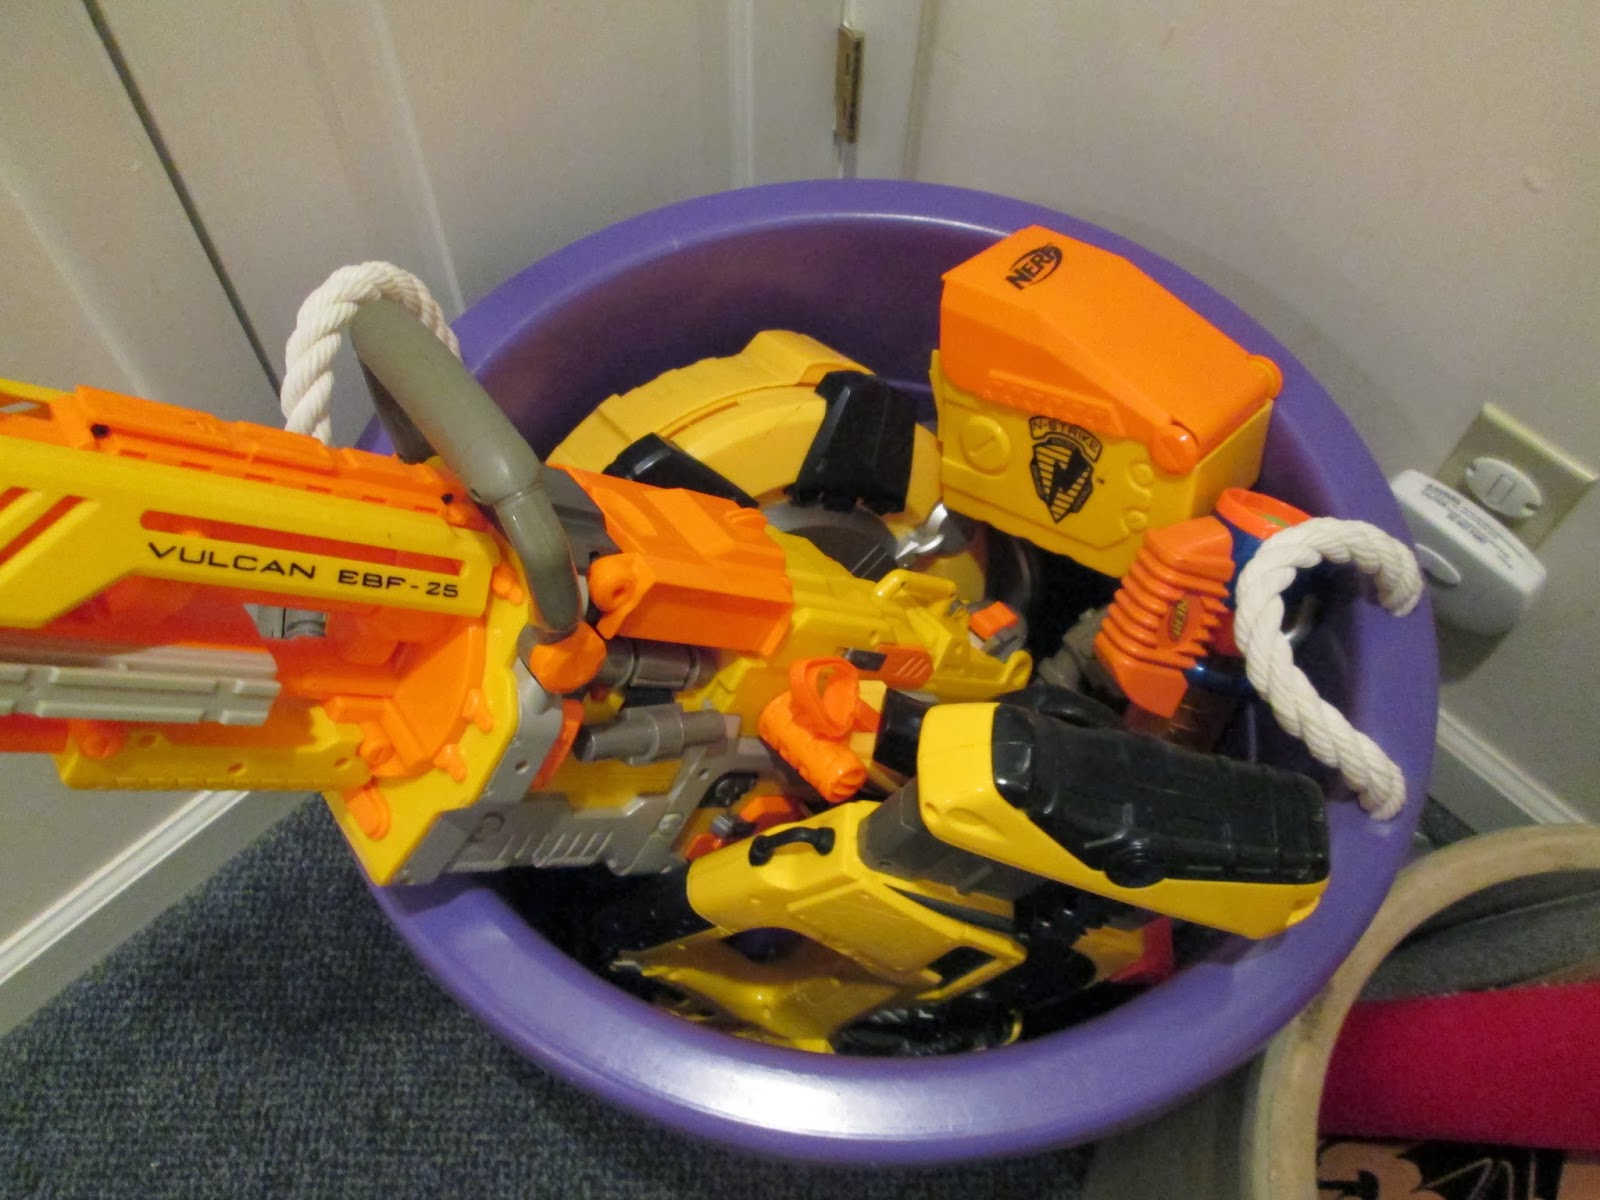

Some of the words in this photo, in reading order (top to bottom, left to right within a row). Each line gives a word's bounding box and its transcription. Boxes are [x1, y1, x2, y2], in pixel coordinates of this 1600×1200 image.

[1005, 245, 1061, 290] NERF
[1030, 418, 1101, 455] N-STRIKE
[148, 542, 316, 579] VULCAN
